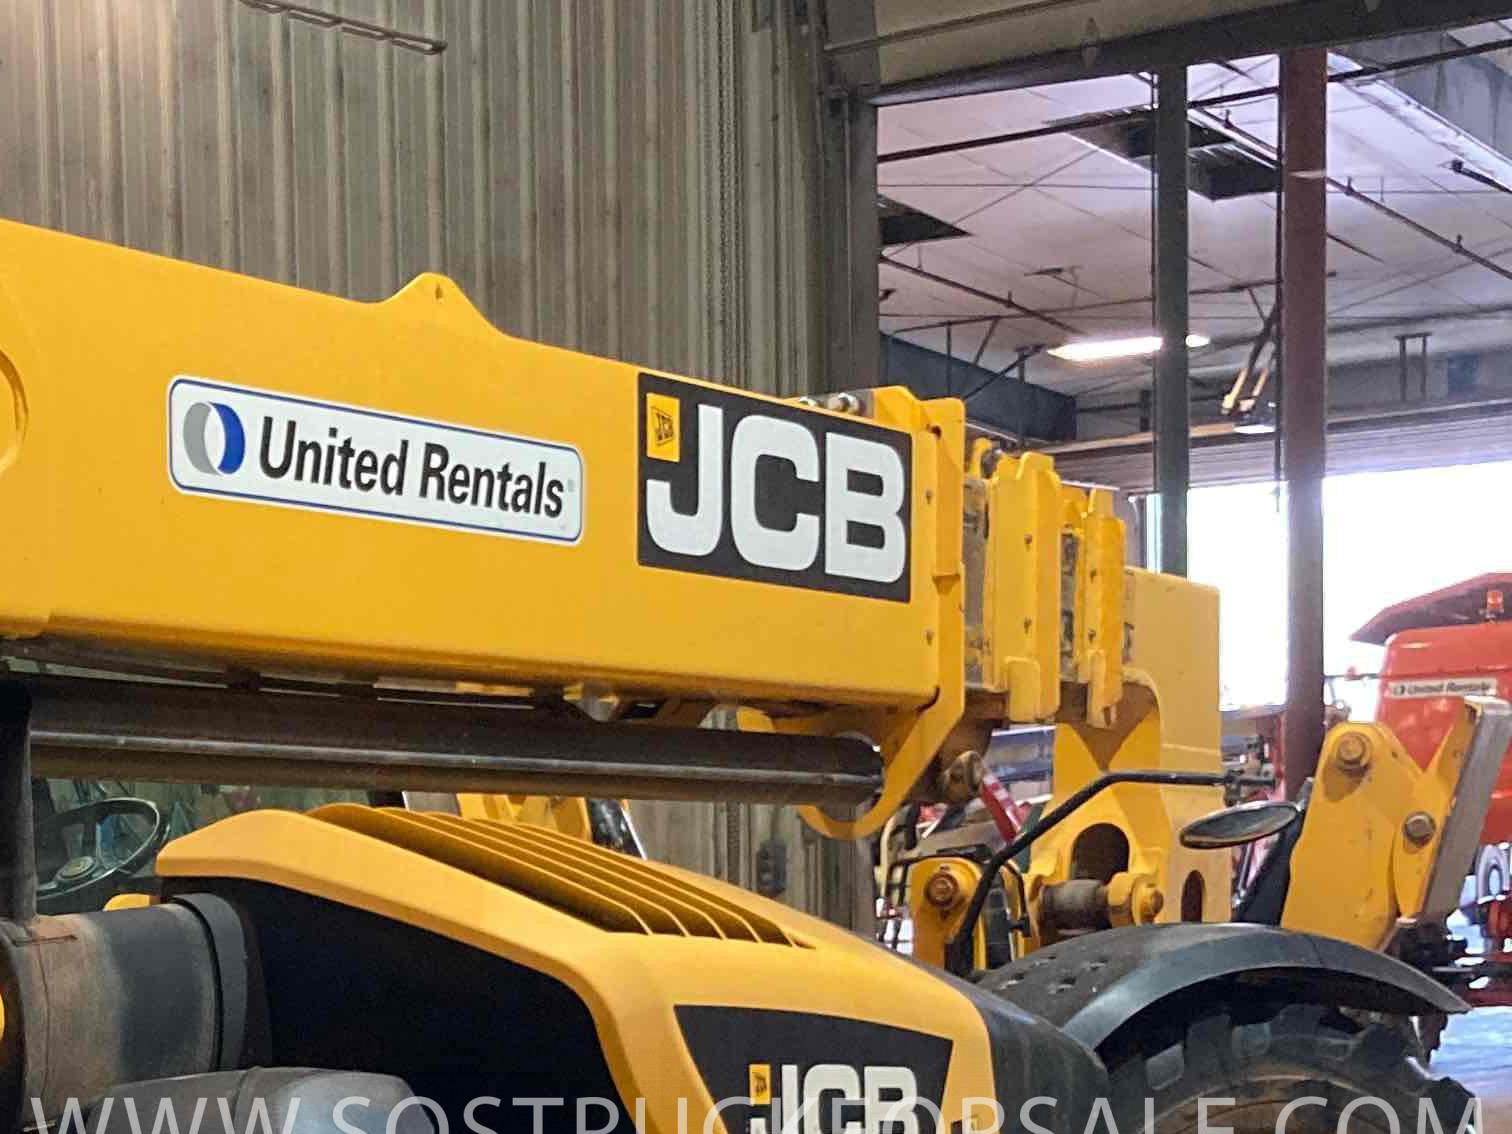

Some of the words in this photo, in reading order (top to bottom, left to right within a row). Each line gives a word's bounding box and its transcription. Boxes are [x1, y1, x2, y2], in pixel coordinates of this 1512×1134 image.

[259, 415, 408, 496] United
[418, 442, 565, 519] Rentals
[645, 404, 907, 584] JCB
